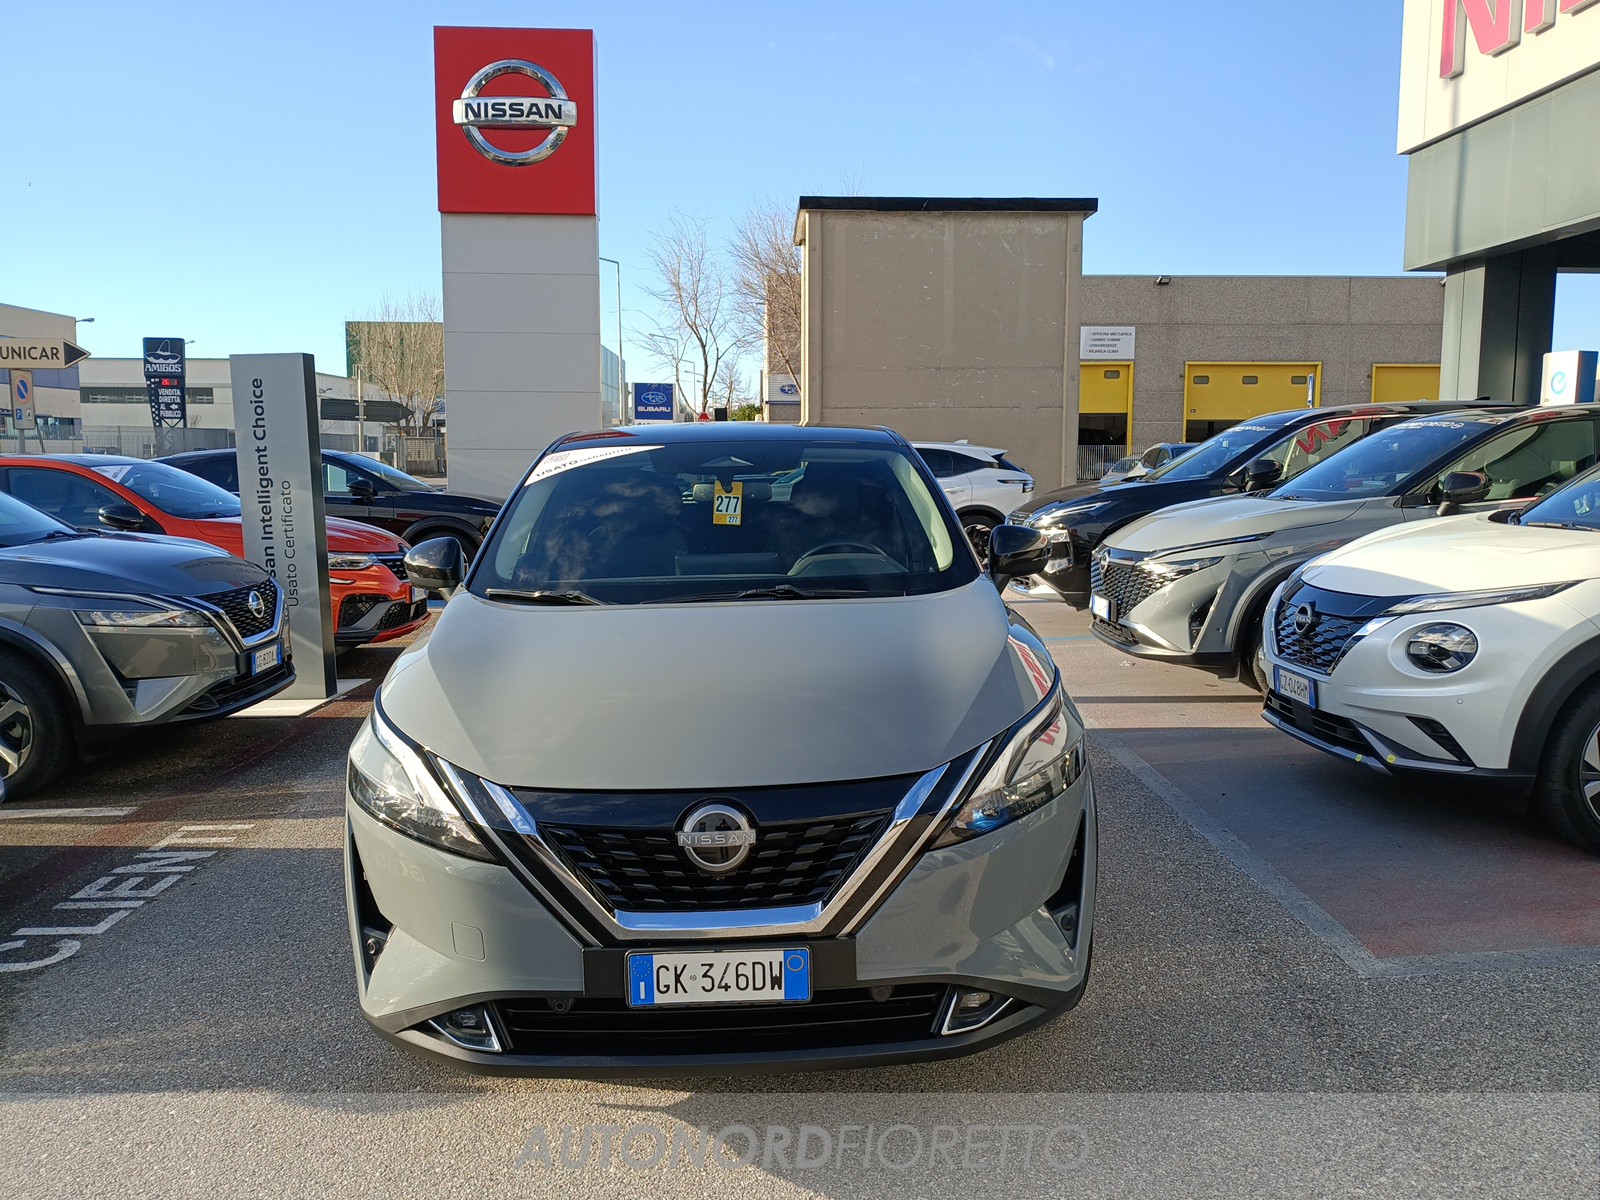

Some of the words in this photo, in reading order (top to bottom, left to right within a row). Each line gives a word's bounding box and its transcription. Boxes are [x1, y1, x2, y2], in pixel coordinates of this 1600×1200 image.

[464, 102, 563, 120] NISSAN
[0, 346, 60, 360] UNICAR
[145, 363, 182, 372] AMIGOS
[158, 388, 181, 396] VENDITA
[250, 378, 266, 441] Choice
[536, 460, 578, 476] USATO
[255, 445, 274, 540] Intelligent
[716, 495, 740, 513] 277
[281, 480, 295, 559] Certificato
[287, 563, 299, 607] Usato
[680, 832, 754, 845] NISSAN
[656, 963, 688, 994] GK
[700, 960, 783, 993] 346DW
